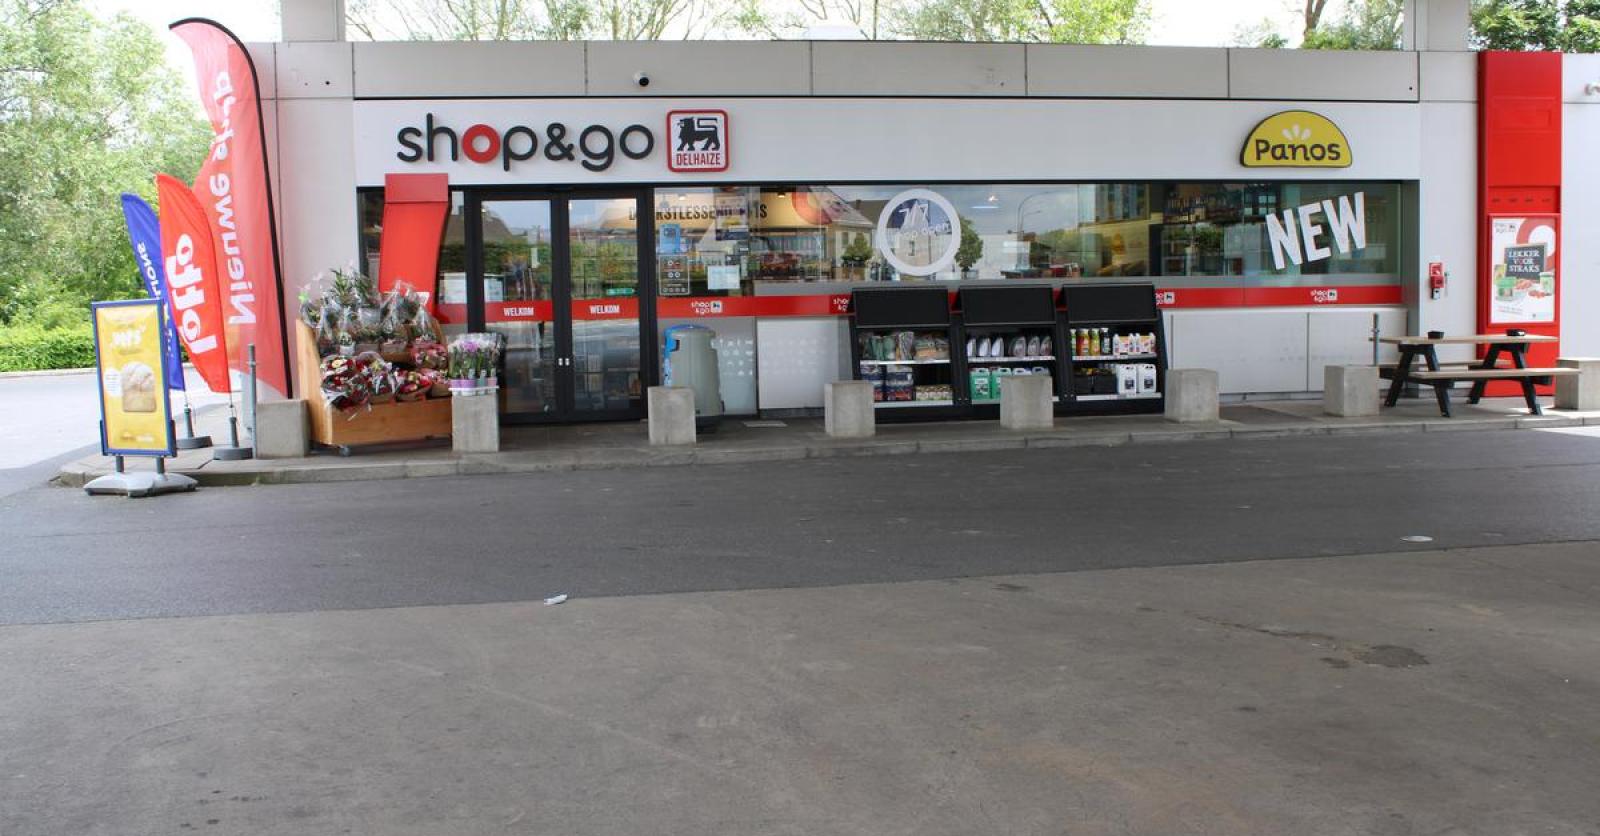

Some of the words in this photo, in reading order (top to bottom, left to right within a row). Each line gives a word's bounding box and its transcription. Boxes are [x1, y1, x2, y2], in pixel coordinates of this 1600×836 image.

[397, 112, 655, 172] shop&go
[1255, 139, 1341, 163] Panos
[676, 153, 721, 166] DELHAIZE
[1265, 191, 1367, 270] NEW
[1508, 250, 1540, 258] LEKKER
[1508, 264, 1540, 273] STRAKS
[503, 307, 535, 317] WELKOM
[589, 304, 620, 315] WELKOM
